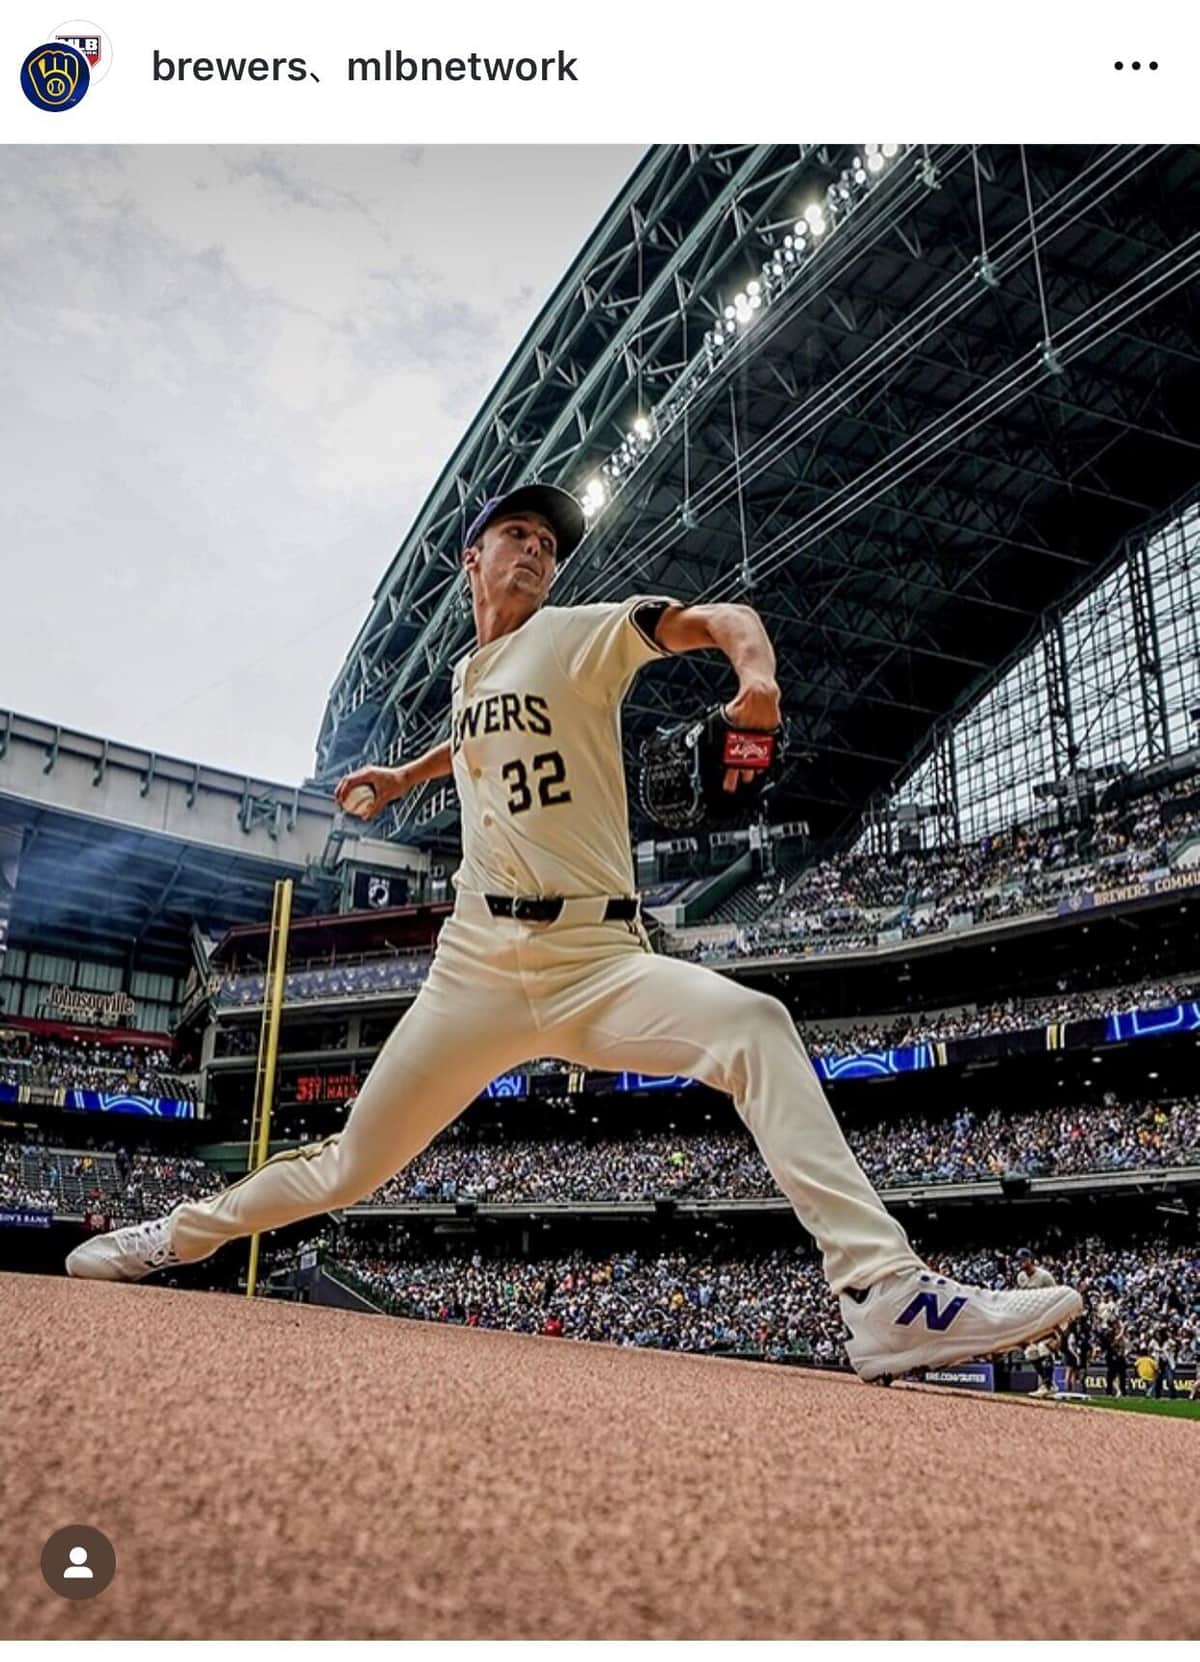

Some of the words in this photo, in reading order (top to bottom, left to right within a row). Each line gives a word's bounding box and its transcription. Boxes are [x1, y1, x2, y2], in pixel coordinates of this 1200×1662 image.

[502, 750, 573, 816] 32
[1093, 883, 1150, 906] BREWERS
[894, 1291, 969, 1332] N
